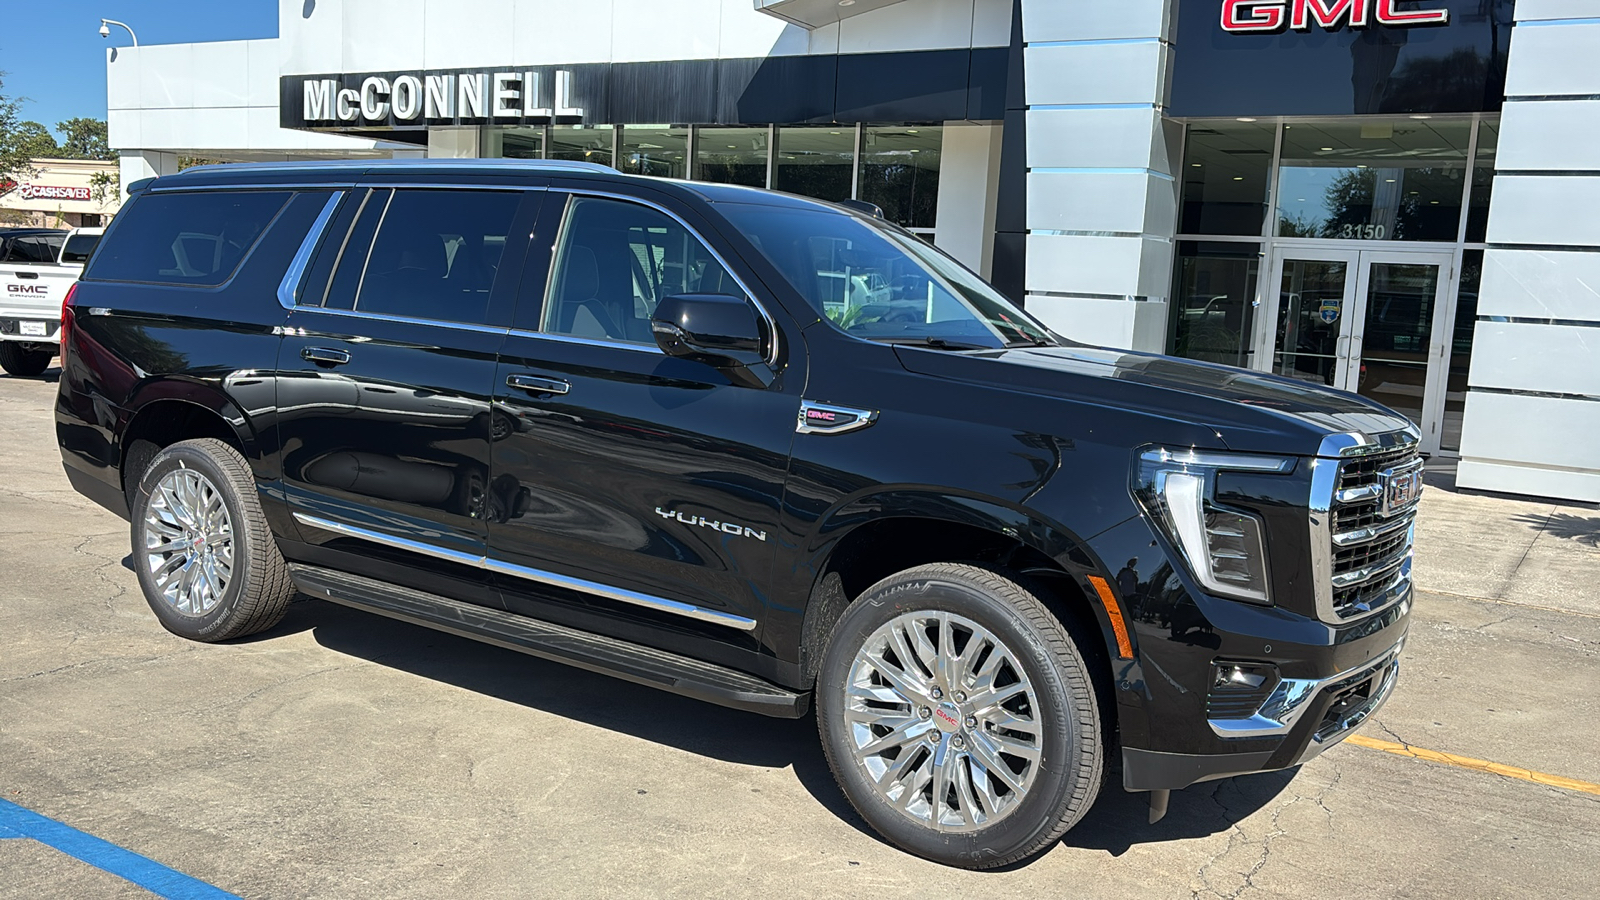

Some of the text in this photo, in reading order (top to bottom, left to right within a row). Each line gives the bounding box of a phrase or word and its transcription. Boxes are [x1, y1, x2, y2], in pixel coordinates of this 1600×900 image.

[1220, 0, 1448, 31] GMC
[303, 70, 583, 122] McCONNELL
[1343, 223, 1385, 239] 3150
[7, 284, 48, 294] GMC
[807, 410, 835, 421] GMC
[655, 506, 767, 541] YUKON
[936, 708, 958, 727] GMC
